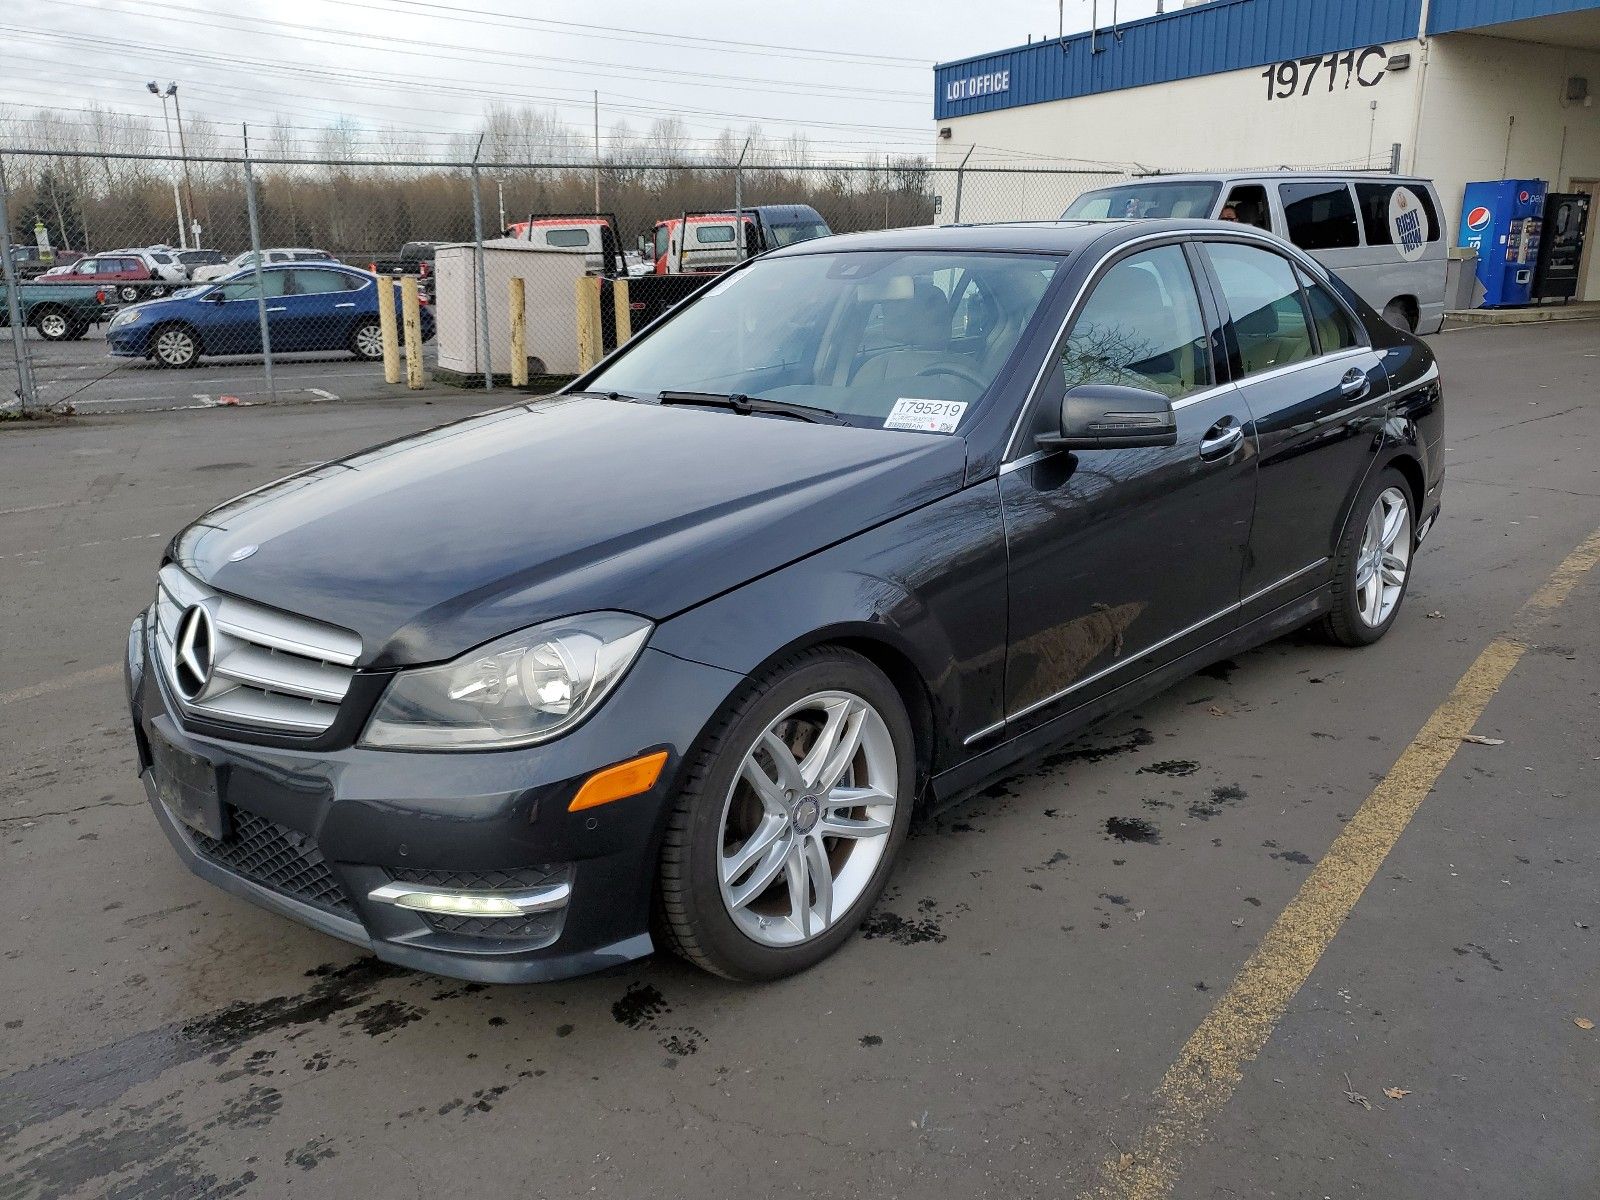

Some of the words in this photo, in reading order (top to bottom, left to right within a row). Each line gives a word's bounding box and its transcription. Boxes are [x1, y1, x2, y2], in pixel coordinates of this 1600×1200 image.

[947, 80, 967, 100] LOT
[969, 71, 1009, 96] OFFICE
[1261, 45, 1387, 101] 19711C
[1395, 208, 1421, 237] RIGHT
[1400, 227, 1423, 255] NOW
[899, 401, 961, 417] 1795219
